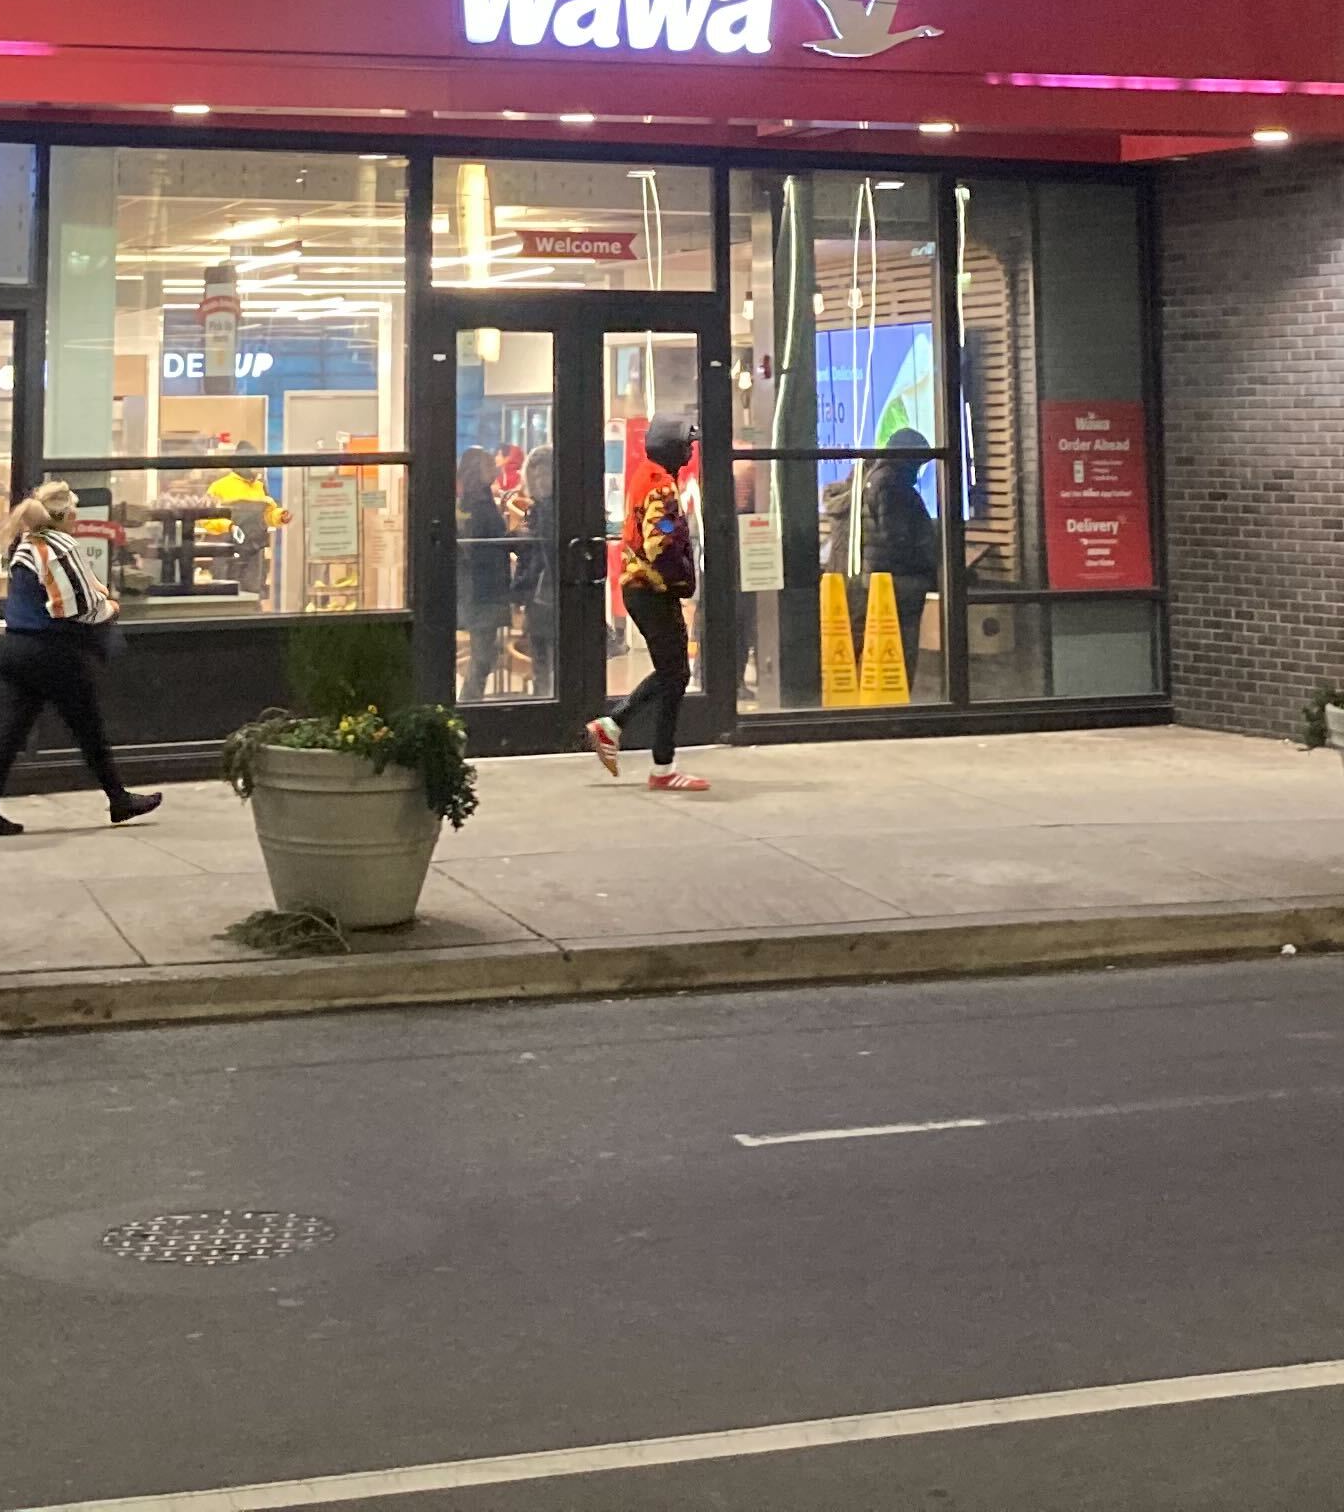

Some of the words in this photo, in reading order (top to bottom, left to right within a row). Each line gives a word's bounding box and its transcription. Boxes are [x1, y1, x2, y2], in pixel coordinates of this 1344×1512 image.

[535, 236, 623, 254] Welcome
[1058, 438, 1092, 452] Order
[1093, 438, 1130, 452] Ahead
[1066, 518, 1119, 535] Delivery
